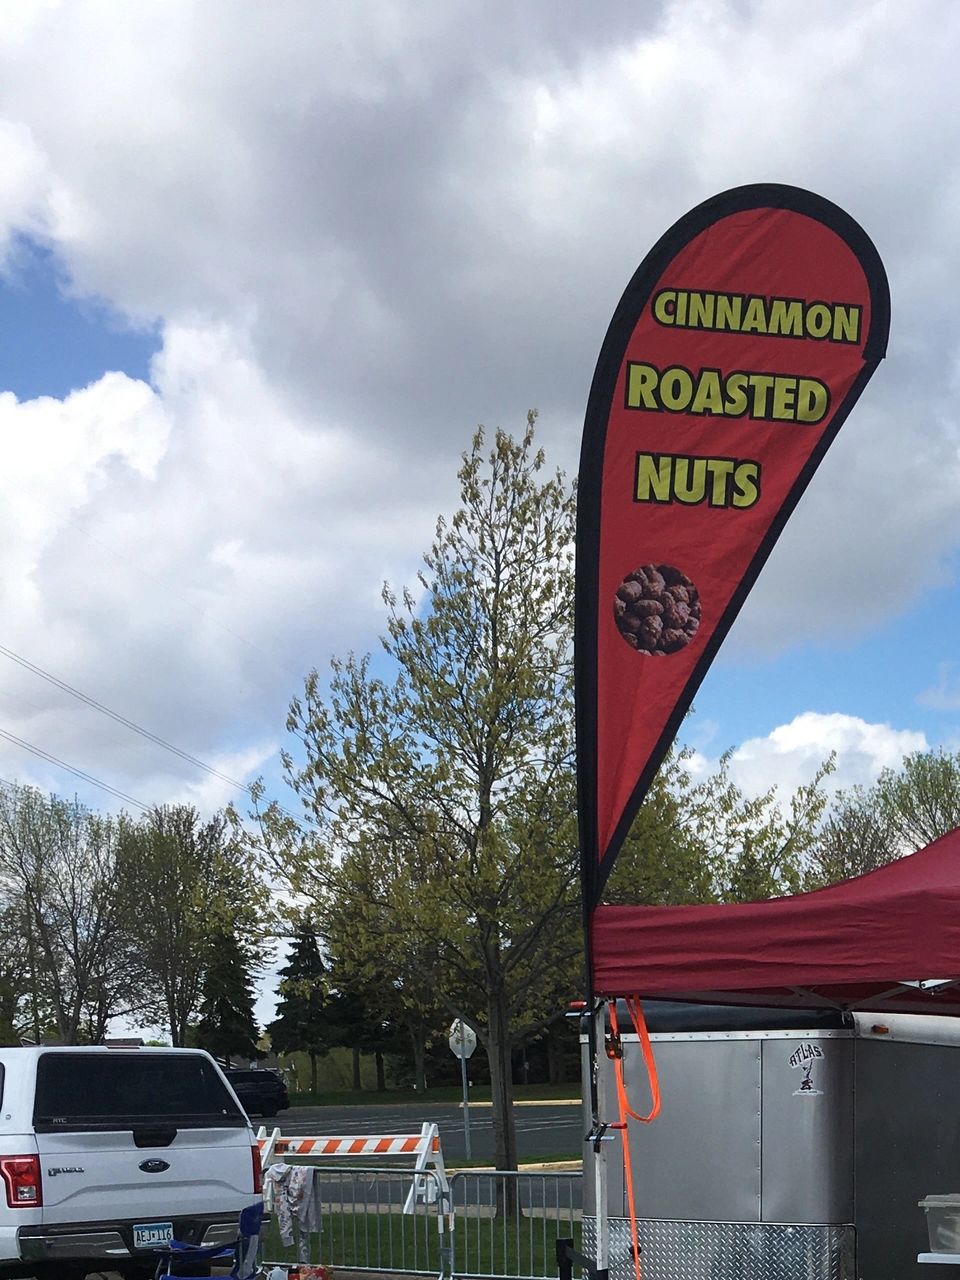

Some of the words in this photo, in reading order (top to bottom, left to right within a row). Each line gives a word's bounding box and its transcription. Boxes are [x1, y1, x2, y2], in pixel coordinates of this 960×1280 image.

[653, 289, 861, 343] CINNAMON
[626, 362, 830, 424] ROASTED
[635, 453, 761, 508] NUTS
[789, 1043, 823, 1067] ATLAS
